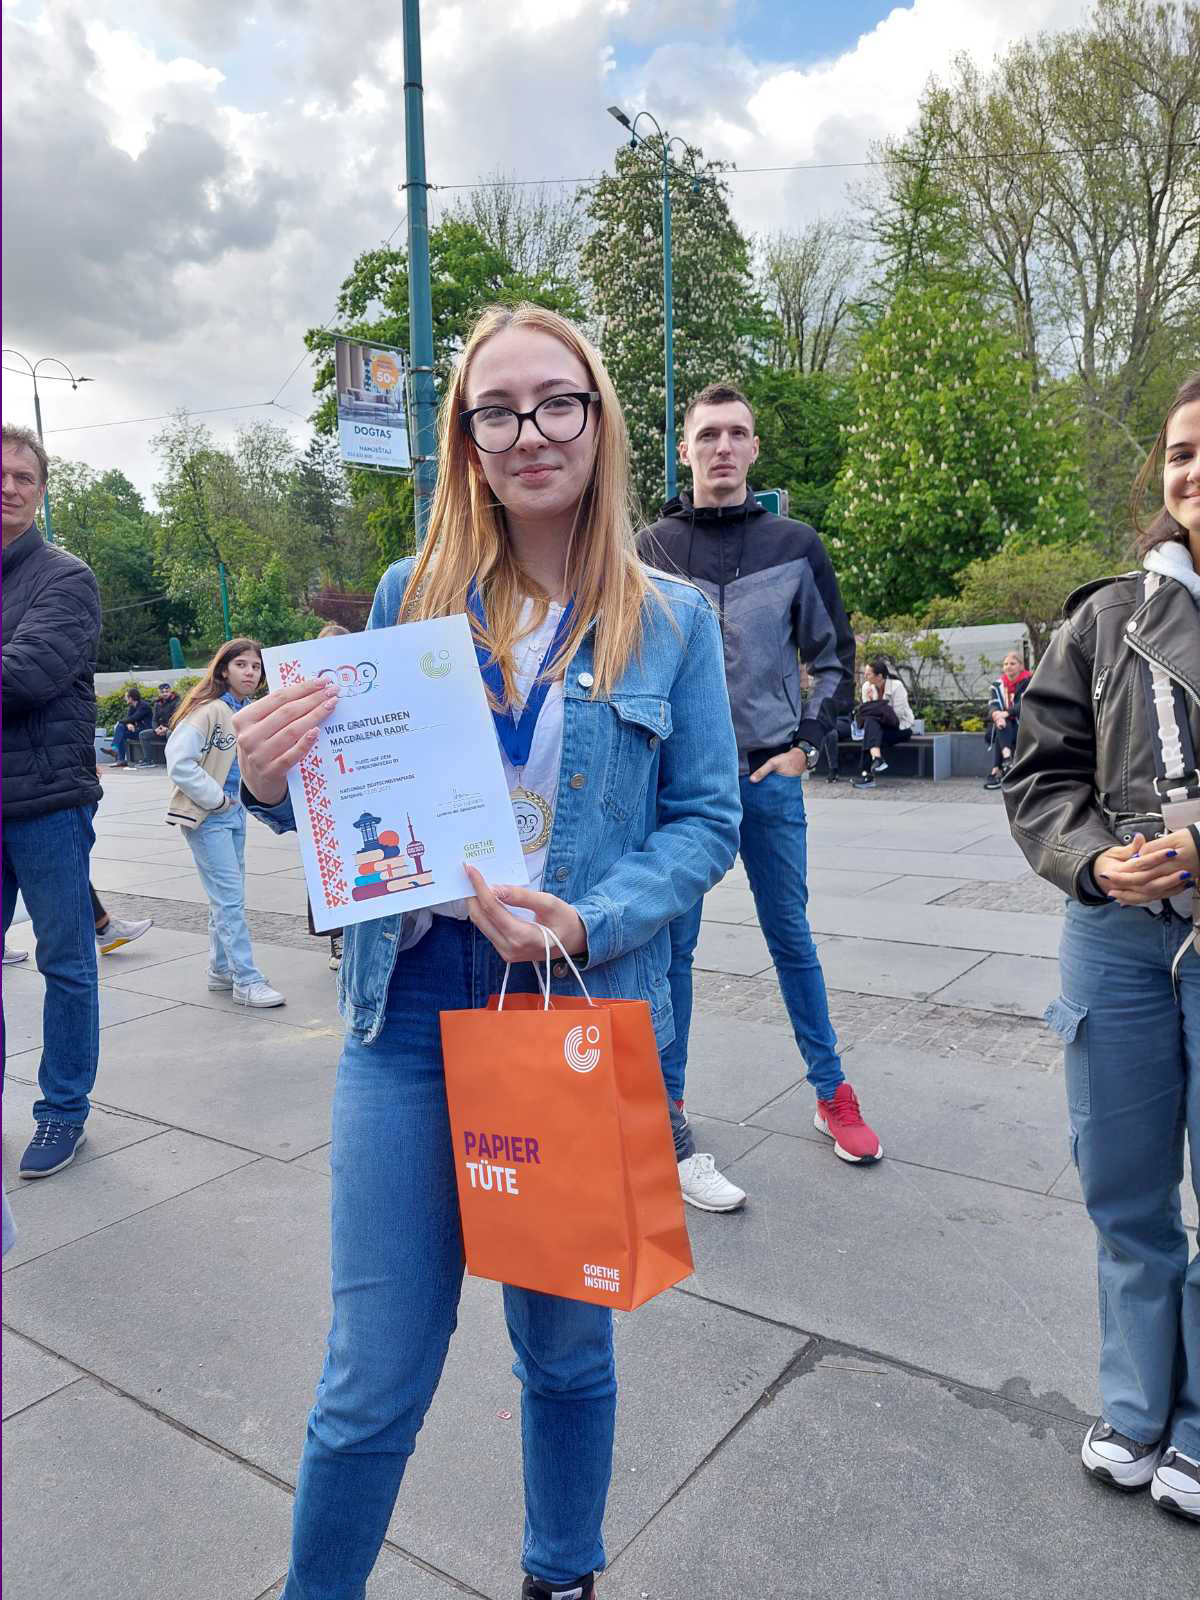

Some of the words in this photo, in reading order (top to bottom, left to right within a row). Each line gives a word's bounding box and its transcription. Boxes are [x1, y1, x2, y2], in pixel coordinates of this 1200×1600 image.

[325, 724, 346, 735] WIR
[347, 711, 410, 731] GRATULIEREN
[330, 729, 382, 747] MAGDALENA
[334, 753, 354, 775] 1.
[464, 840, 493, 851] GOETHE
[465, 847, 496, 859] INSTITUT
[463, 1131, 541, 1164] PAPIER
[465, 1160, 519, 1195] TÜTE
[583, 1263, 620, 1281] GOETHE
[584, 1277, 620, 1293] INSTITUT
